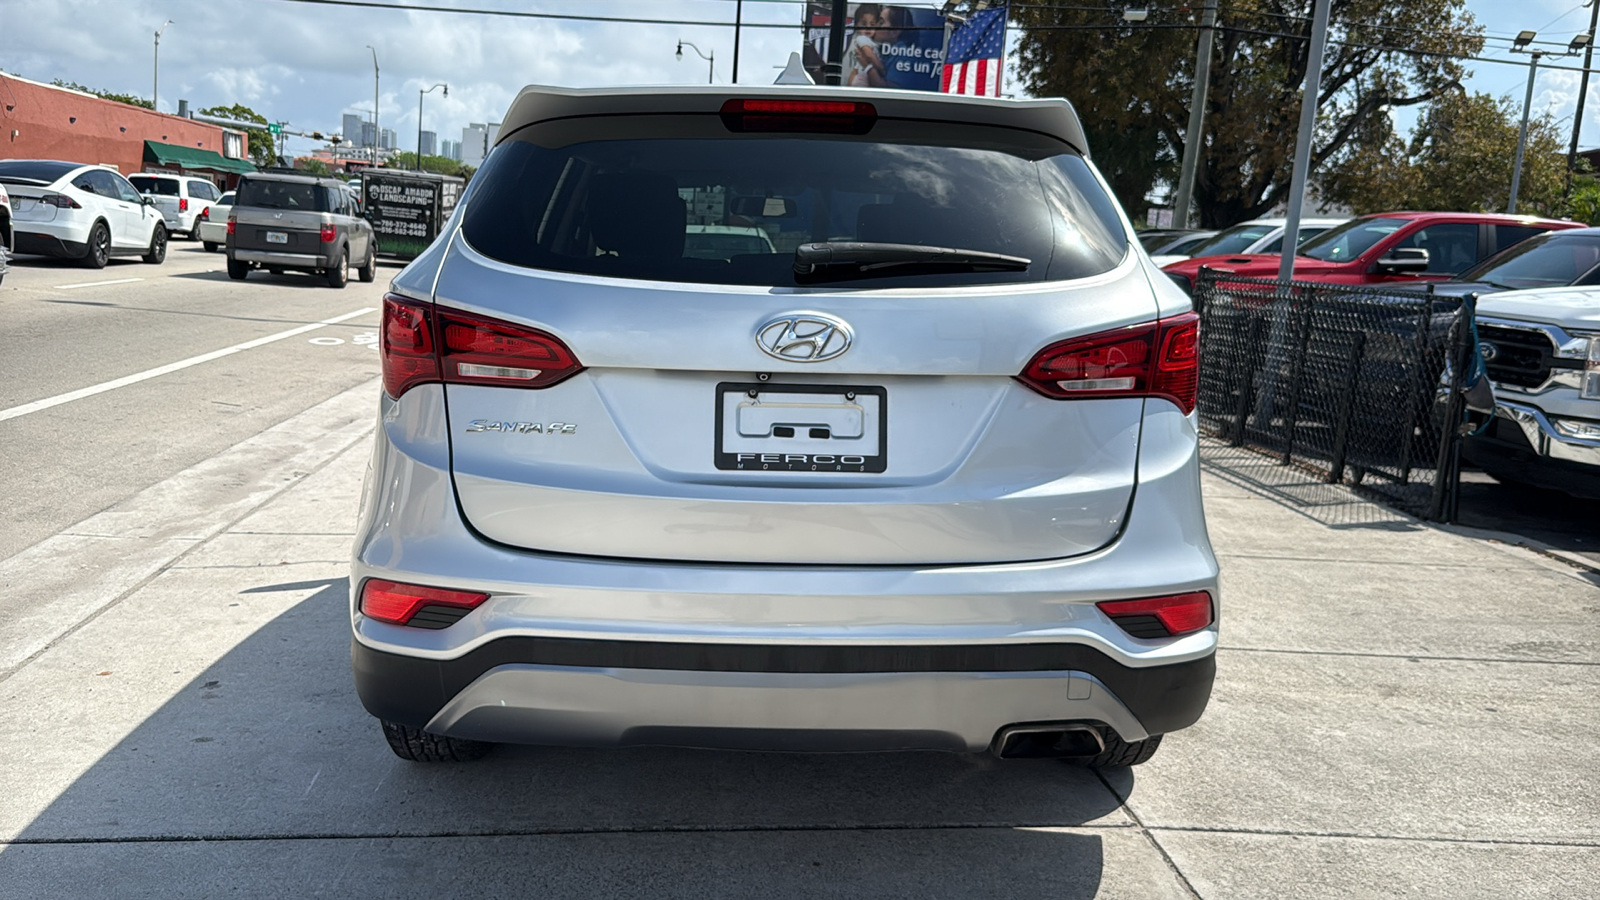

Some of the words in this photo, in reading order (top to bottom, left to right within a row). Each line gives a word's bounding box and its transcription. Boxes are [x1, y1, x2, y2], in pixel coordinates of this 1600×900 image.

[881, 43, 922, 58] Donde
[896, 60, 911, 72] es
[914, 62, 930, 73] un
[405, 187, 434, 198] AMADOR
[379, 193, 428, 205] LANDSCAPING
[466, 419, 543, 434] SANTA
[546, 421, 577, 435] FE
[737, 453, 865, 465] FERCO
[737, 463, 865, 471] MOTORS
